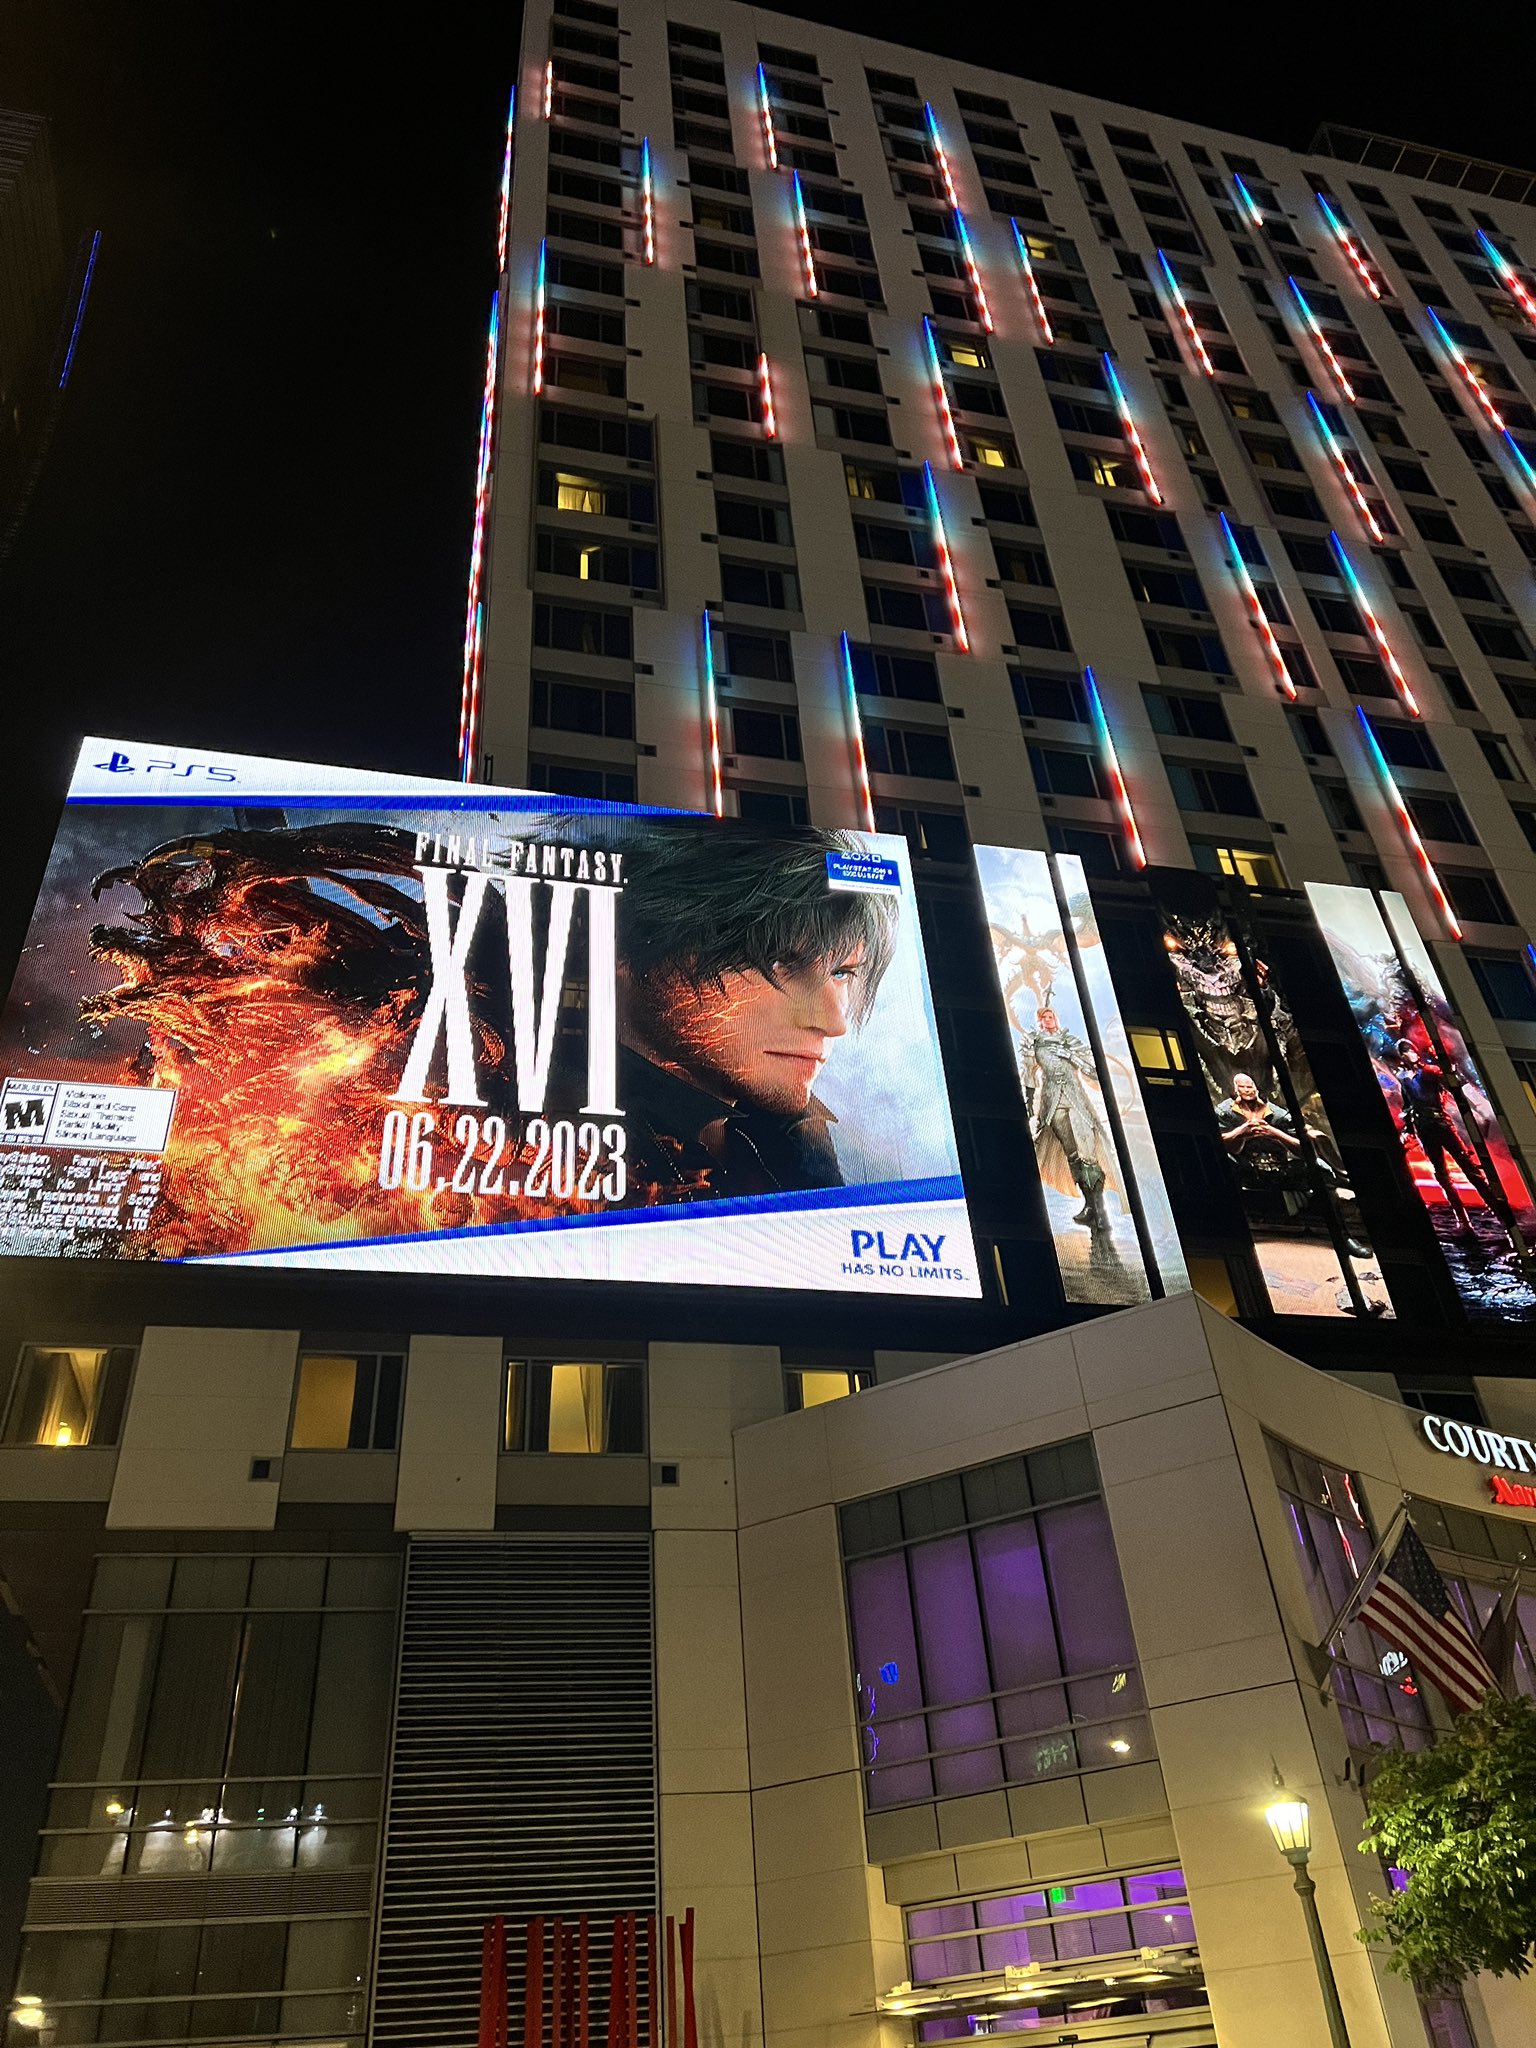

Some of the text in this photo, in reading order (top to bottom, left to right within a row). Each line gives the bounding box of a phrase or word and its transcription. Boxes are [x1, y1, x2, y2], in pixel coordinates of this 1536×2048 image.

[147, 759, 238, 783] PS5
[414, 831, 492, 867] FINAL
[388, 865, 627, 1117] XVI
[5, 1098, 46, 1131] M
[378, 1110, 628, 1203] 06.22.2023
[851, 1229, 947, 1263] PLAY
[842, 1262, 875, 1276] HAS
[879, 1264, 904, 1278] NO
